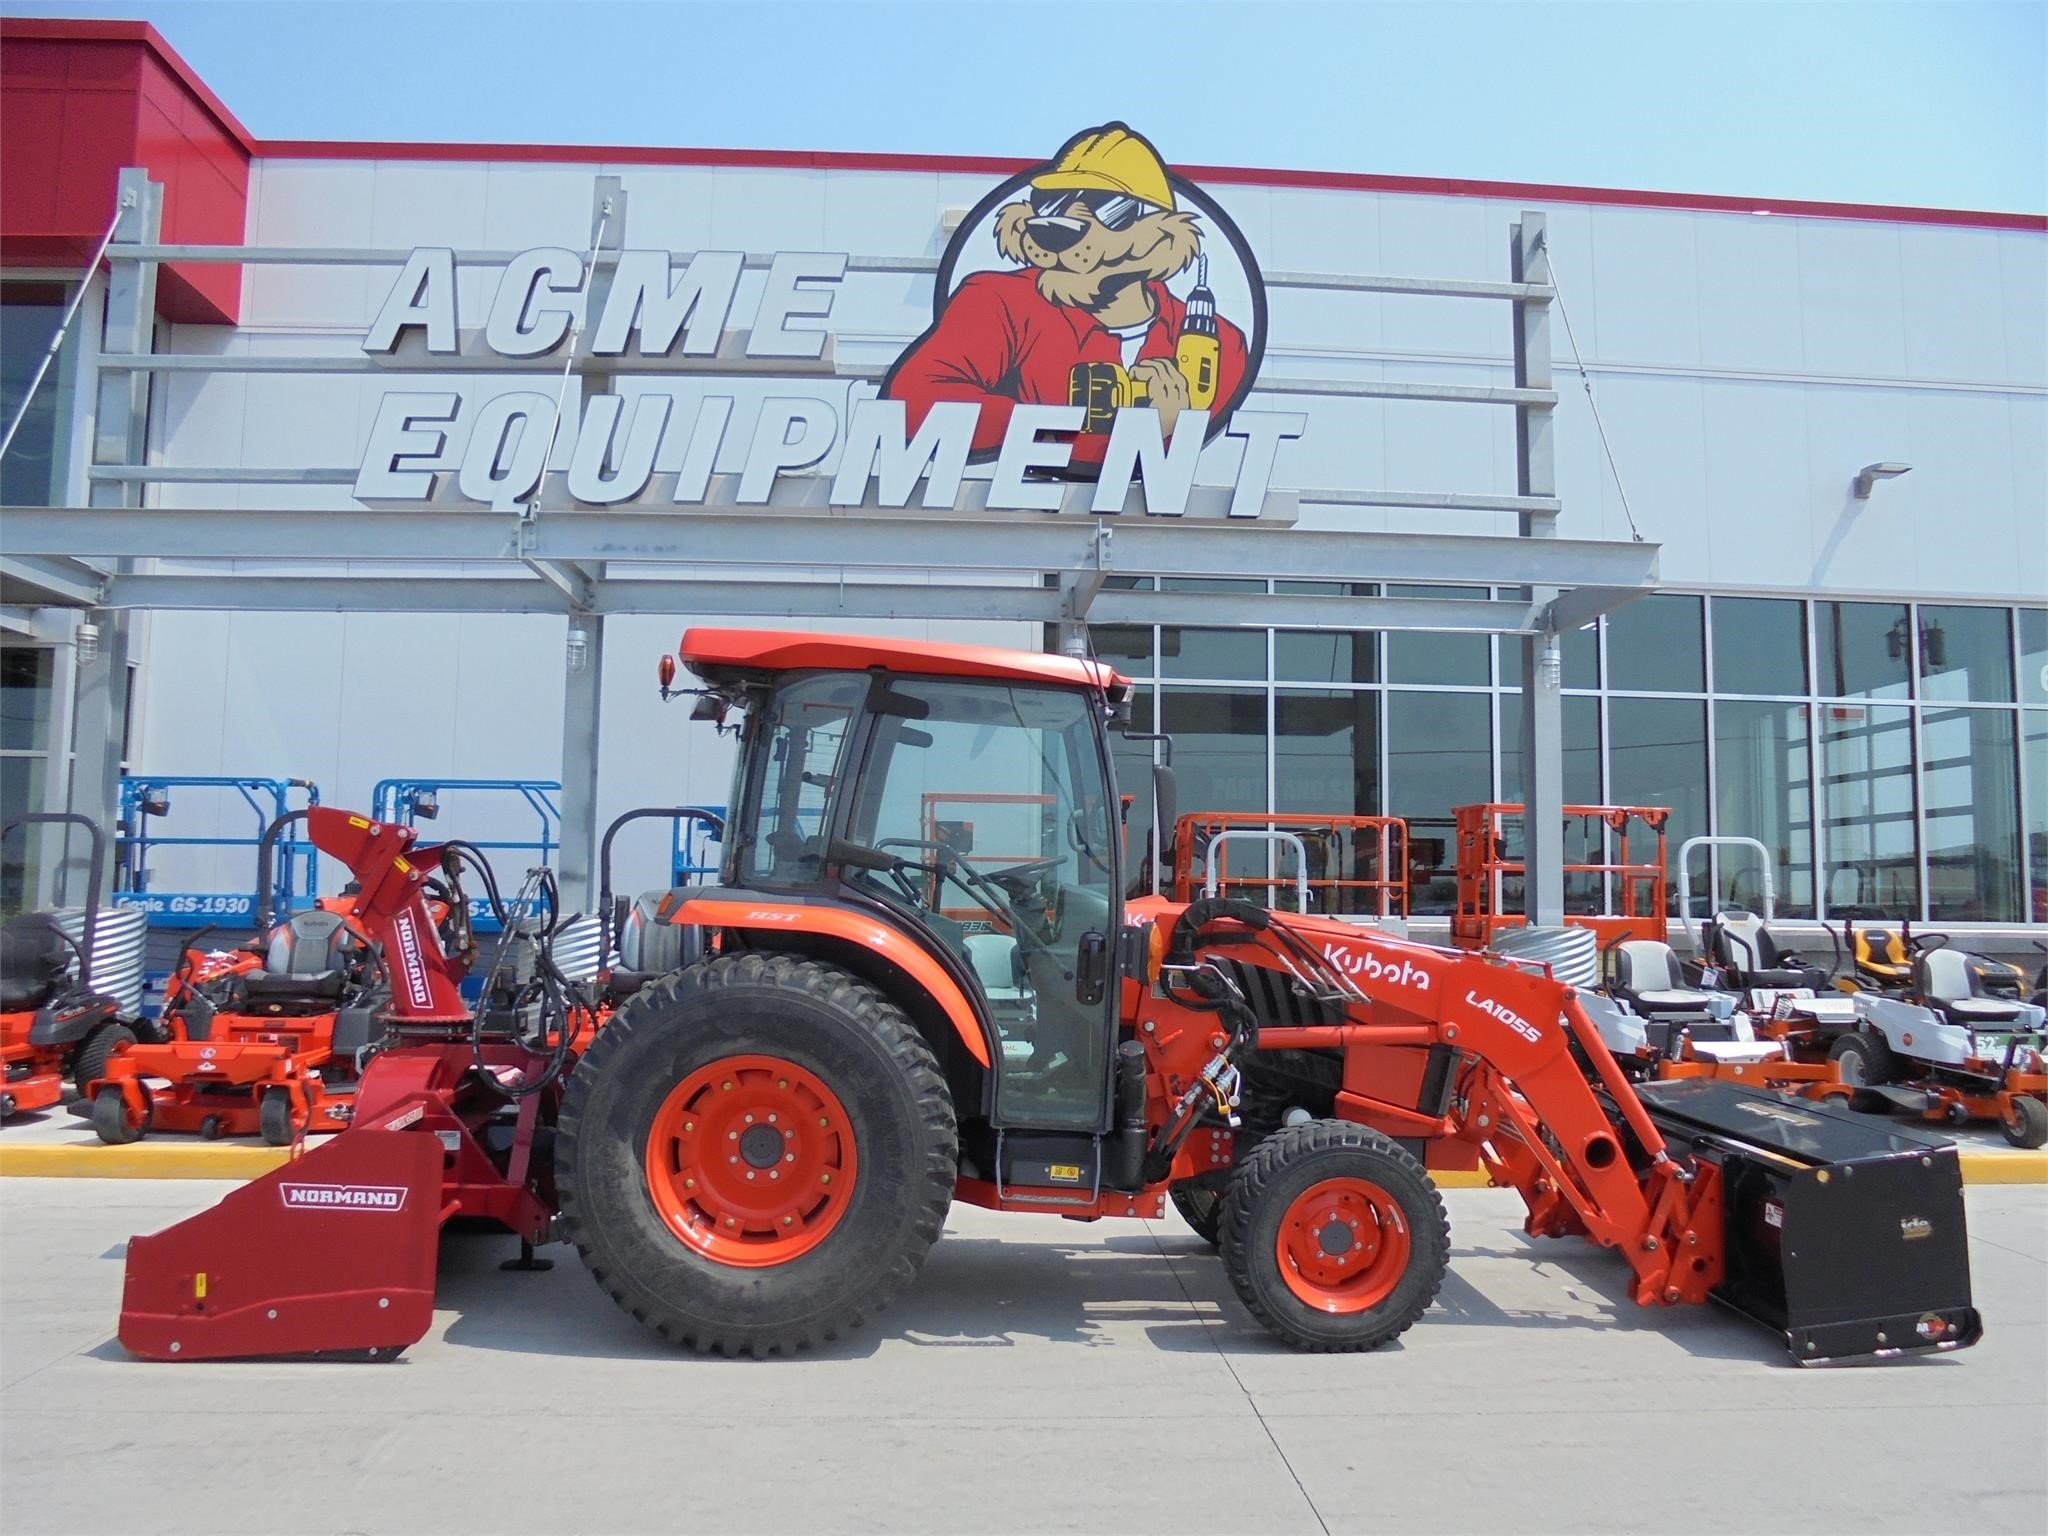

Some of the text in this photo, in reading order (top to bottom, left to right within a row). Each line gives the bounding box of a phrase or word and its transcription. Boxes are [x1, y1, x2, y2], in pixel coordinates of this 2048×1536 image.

[362, 247, 849, 359] ACME
[354, 391, 1307, 517] EQUIPMENT
[170, 896, 250, 913] GS-1930
[746, 911, 802, 921] HST
[398, 917, 427, 1003] NORMAND
[1323, 943, 1430, 990] Kubota
[1465, 990, 1542, 1043] LA1055
[290, 1189, 398, 1206] NORMAND
